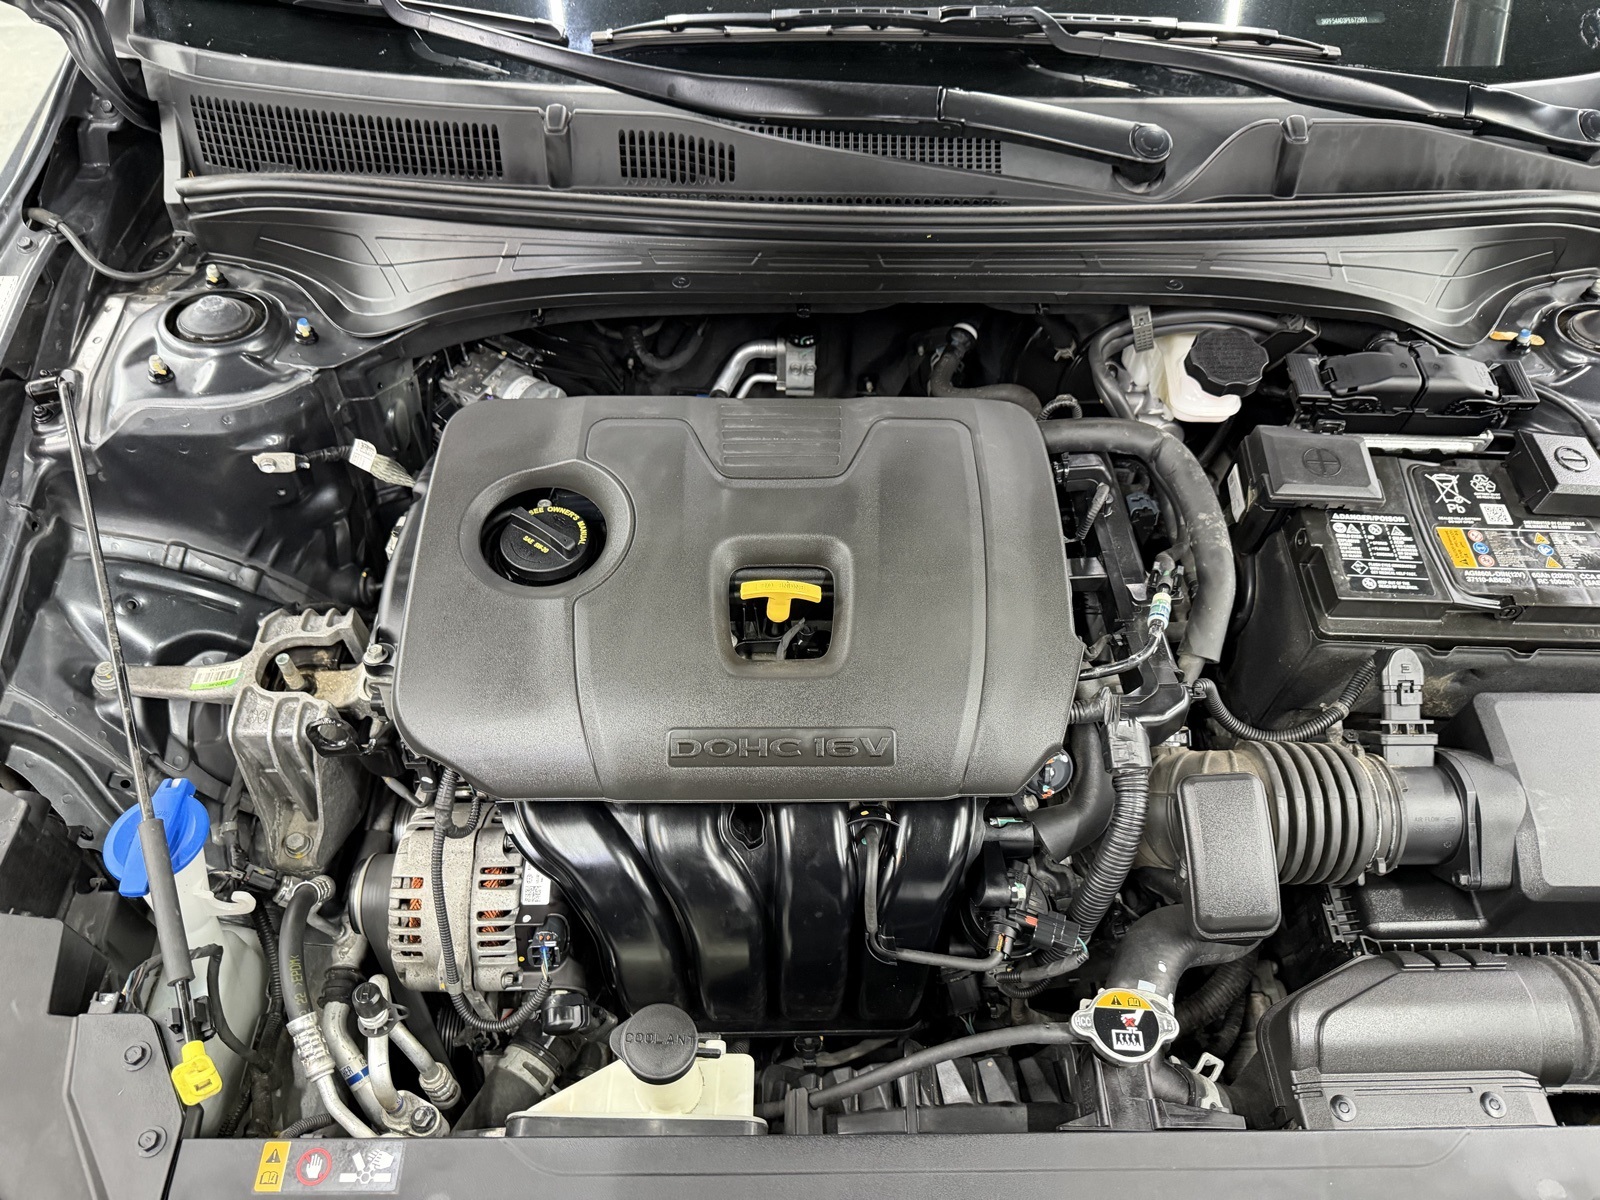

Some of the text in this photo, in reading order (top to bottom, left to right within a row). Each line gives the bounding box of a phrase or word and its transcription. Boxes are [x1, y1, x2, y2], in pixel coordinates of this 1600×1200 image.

[528, 507, 545, 516] SEE
[547, 506, 580, 521] OWNER'S
[1446, 503, 1466, 514] Pb
[670, 737, 892, 758] DOHC 16V
[1074, 1016, 1092, 1027] HCC
[625, 1032, 695, 1047] COOLANT
